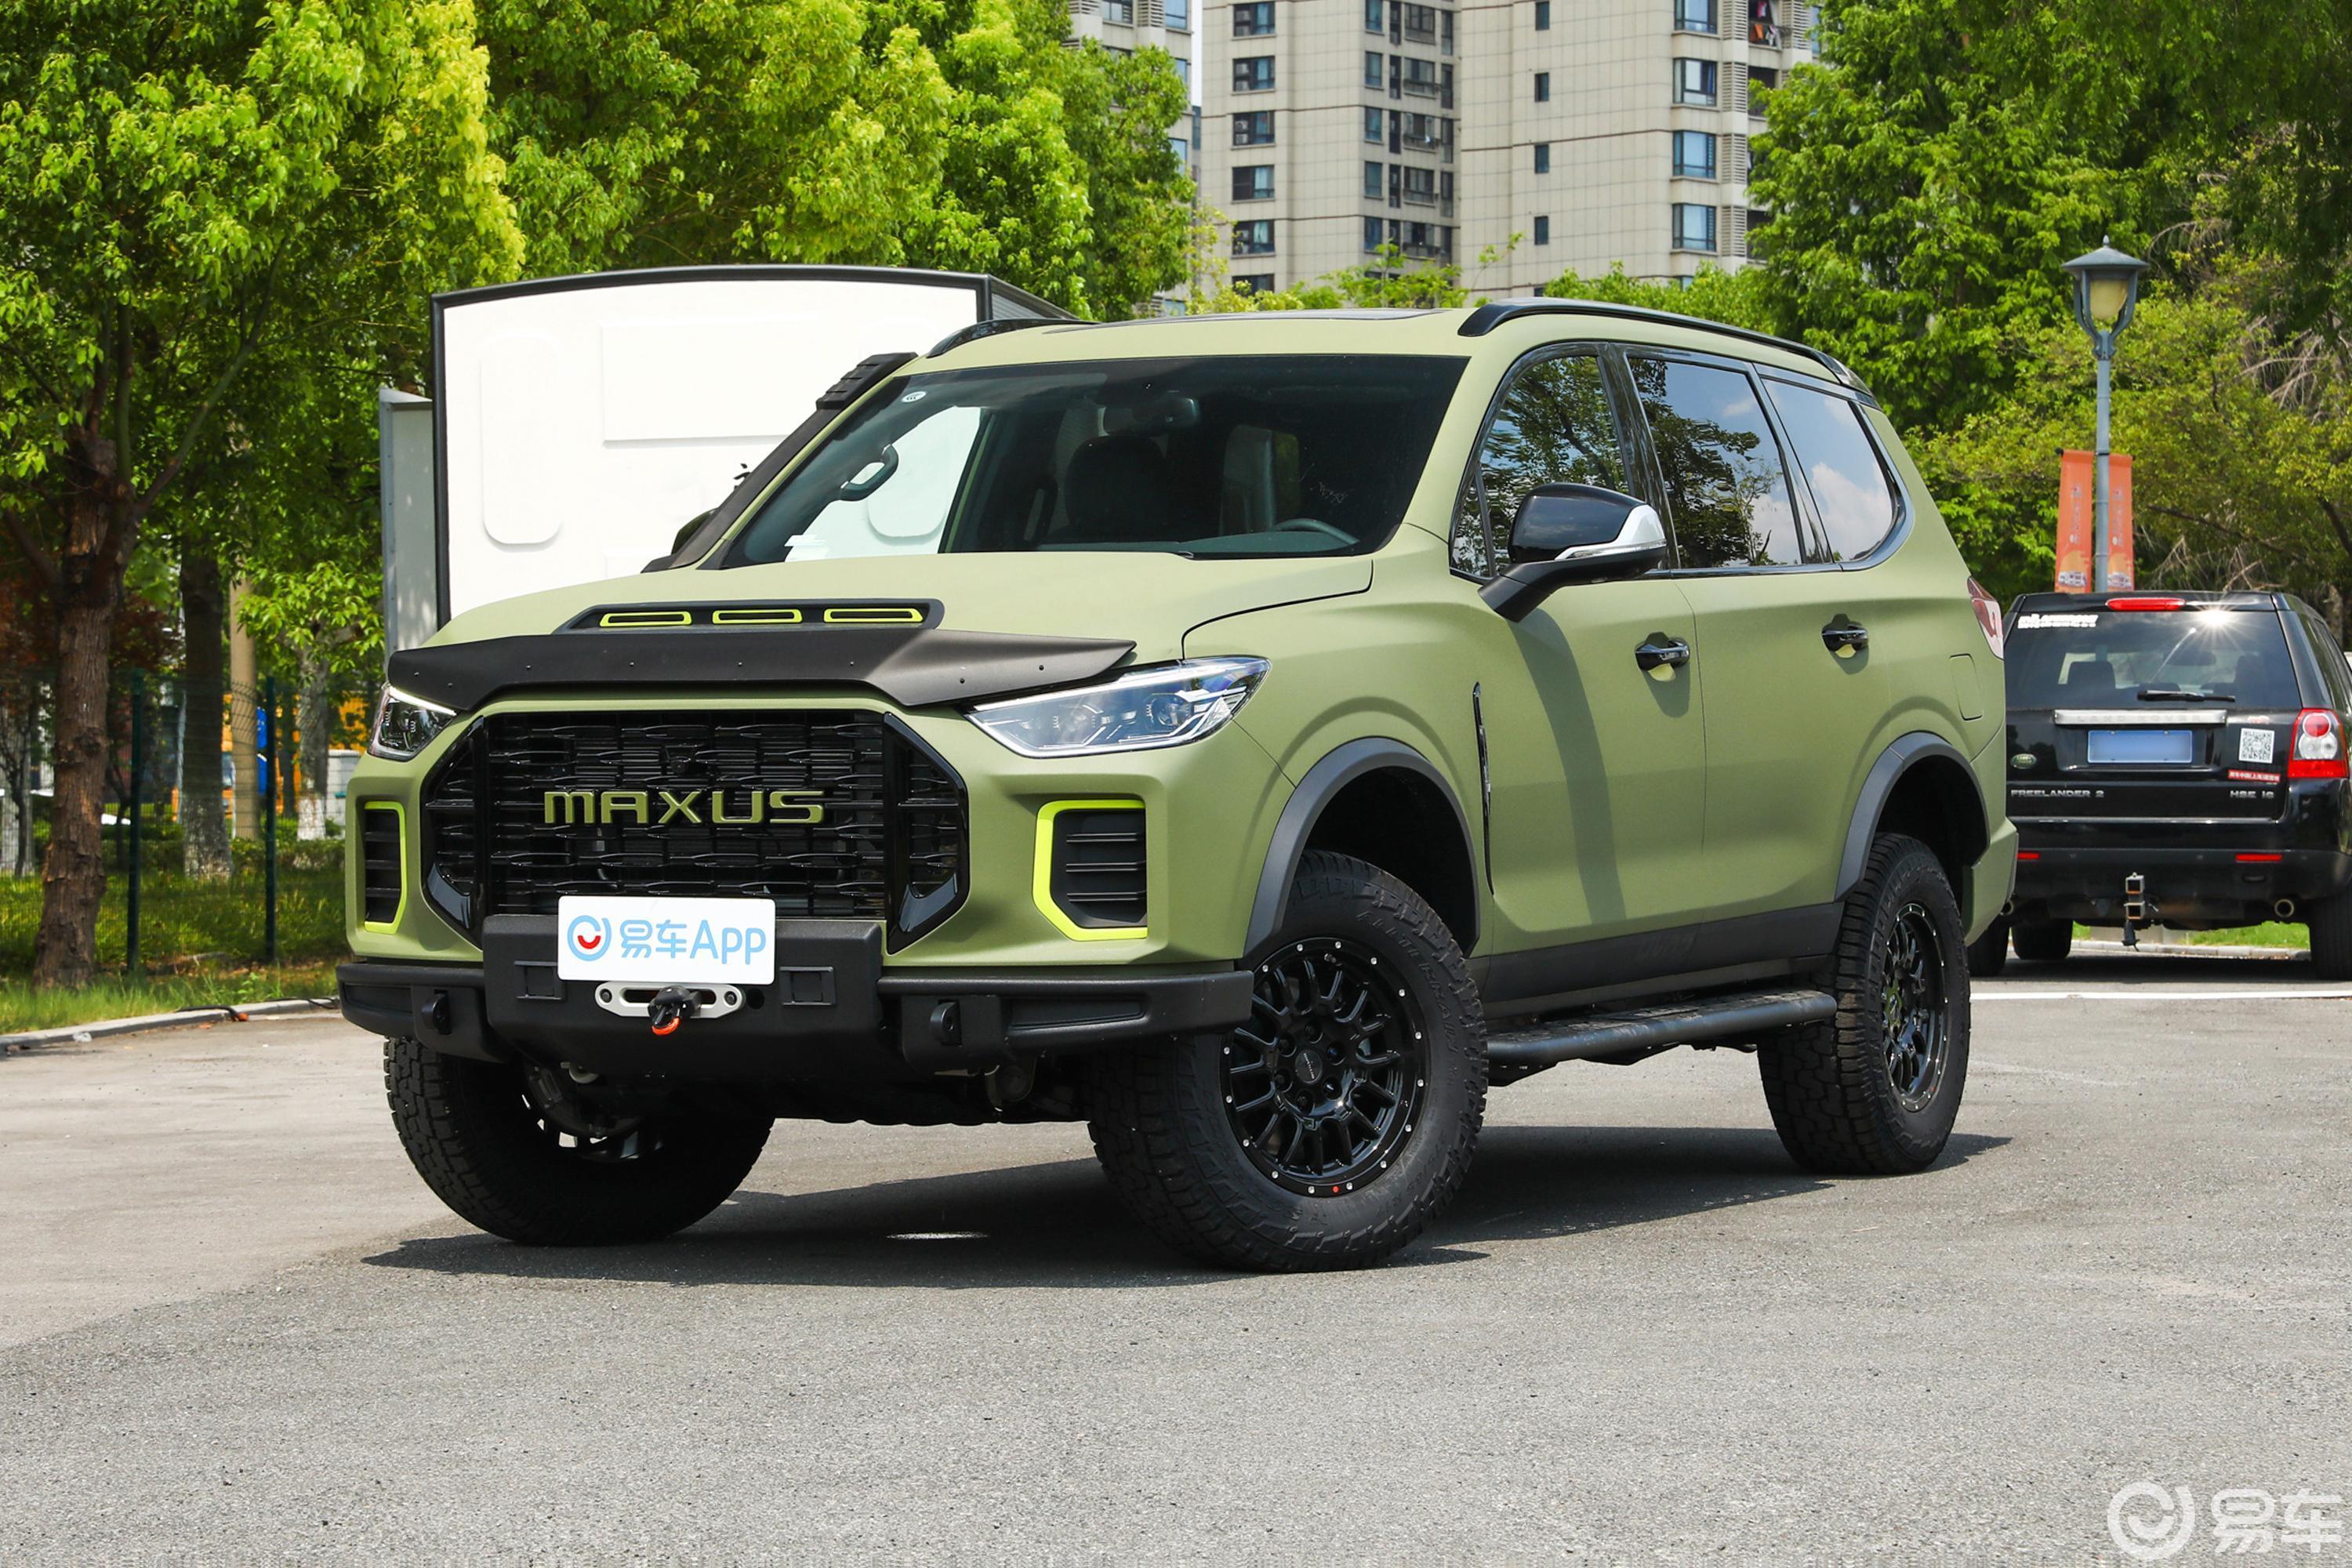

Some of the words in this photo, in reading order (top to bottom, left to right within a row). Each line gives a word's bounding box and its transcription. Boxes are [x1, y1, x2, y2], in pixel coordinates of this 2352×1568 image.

[543, 789, 826, 826] MAXUS
[2010, 789, 2091, 798] FREELANDER
[2095, 789, 2105, 798] 2
[619, 918, 768, 965] 易车App
